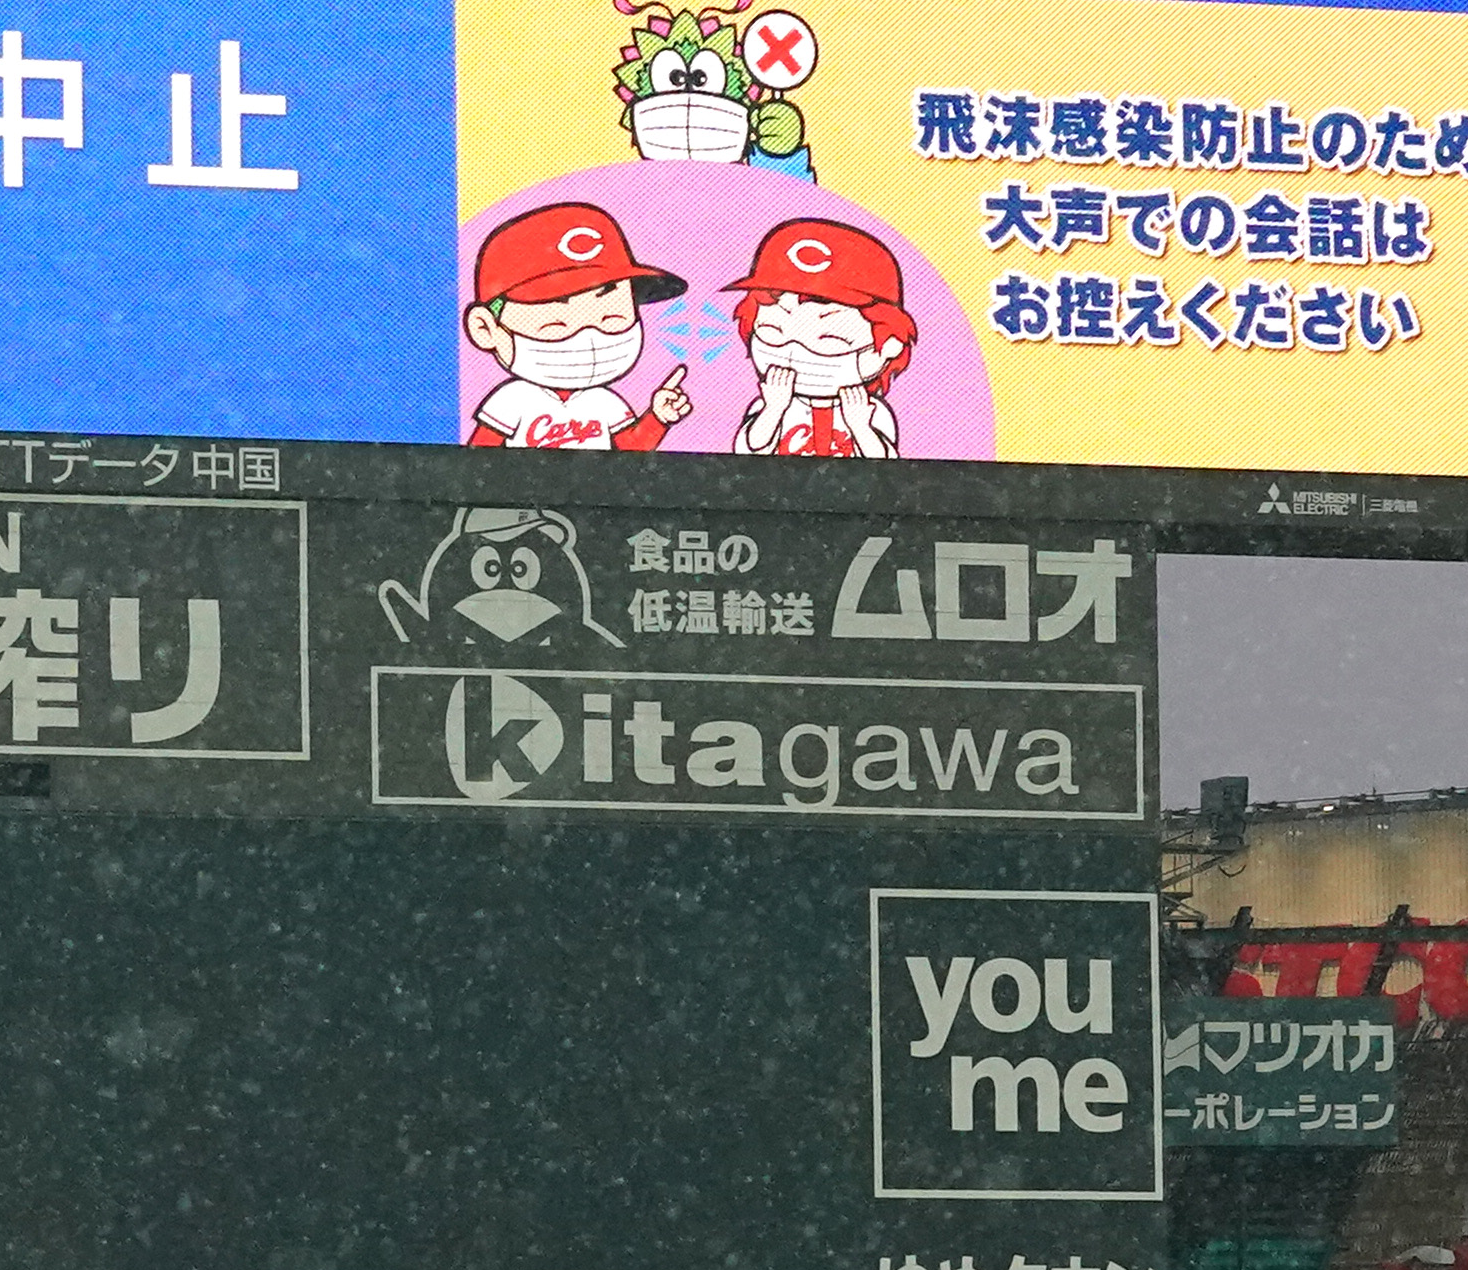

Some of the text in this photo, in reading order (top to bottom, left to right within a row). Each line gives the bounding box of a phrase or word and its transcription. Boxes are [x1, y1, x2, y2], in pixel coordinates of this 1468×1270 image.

[982, 188, 1431, 263] 大声での会話は
[991, 273, 1418, 352] お控えください
[525, 414, 603, 448] Carp
[1293, 491, 1357, 504] MITSUBISHI
[1293, 504, 1349, 515] ELECTRIC
[627, 528, 759, 576] 食品の
[627, 590, 815, 637] 低温輸送
[831, 536, 1131, 643] ムロオ
[905, 957, 1112, 1058] you
[1204, 1020, 1393, 1074] マツオカ
[951, 1056, 1128, 1133] me
